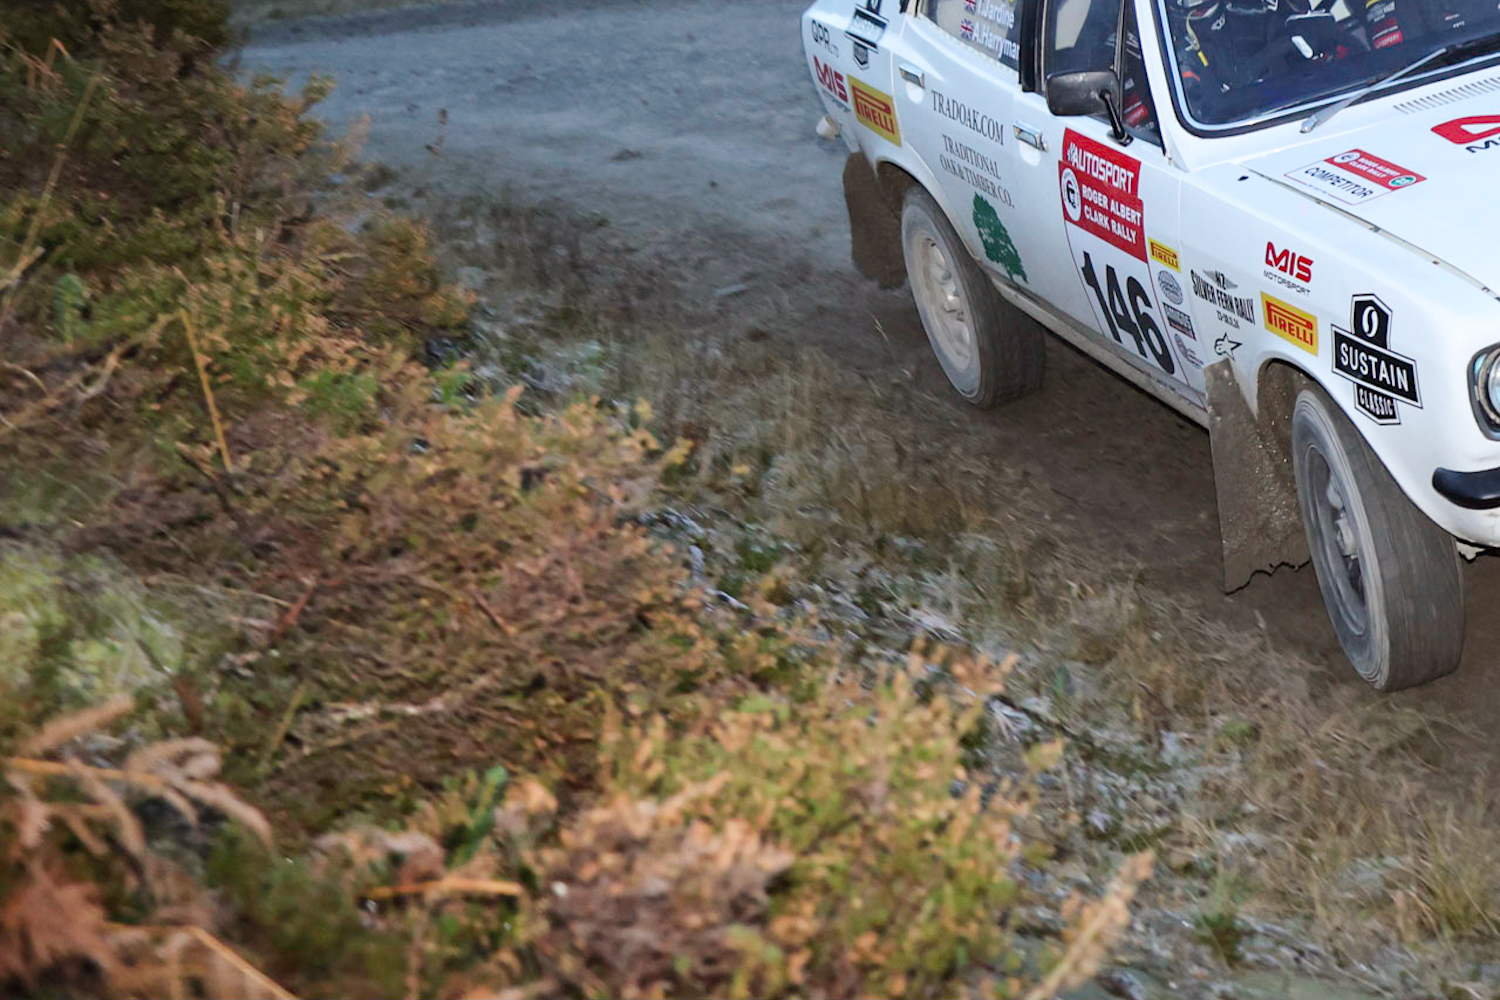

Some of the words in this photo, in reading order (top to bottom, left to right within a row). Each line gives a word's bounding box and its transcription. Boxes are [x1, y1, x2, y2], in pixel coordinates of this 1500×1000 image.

[814, 55, 848, 103] MIS
[852, 85, 895, 135] PIRELLI
[931, 90, 1004, 146] TRADOAK.COM
[942, 134, 1001, 180] TRADITIONAL
[1071, 146, 1134, 194] AUTOSPORT
[1082, 184, 1108, 209] ROGER
[1110, 199, 1141, 226] ALBERT
[1304, 167, 1374, 198] COMPETITOR
[1084, 205, 1110, 231] CLARK
[1111, 220, 1137, 244] RALLY
[1150, 242, 1179, 270] PIRELLI
[1265, 241, 1314, 283] MIS
[1190, 269, 1217, 305] SILVER
[1216, 289, 1235, 314] FERN
[1234, 297, 1255, 325] RALLY
[1263, 270, 1311, 298] MOTORSPORT
[1081, 250, 1175, 375] 146
[1265, 300, 1313, 346] PIRELLI
[1340, 343, 1409, 392] SUSTAIN
[1359, 388, 1394, 415] CLASSIC
